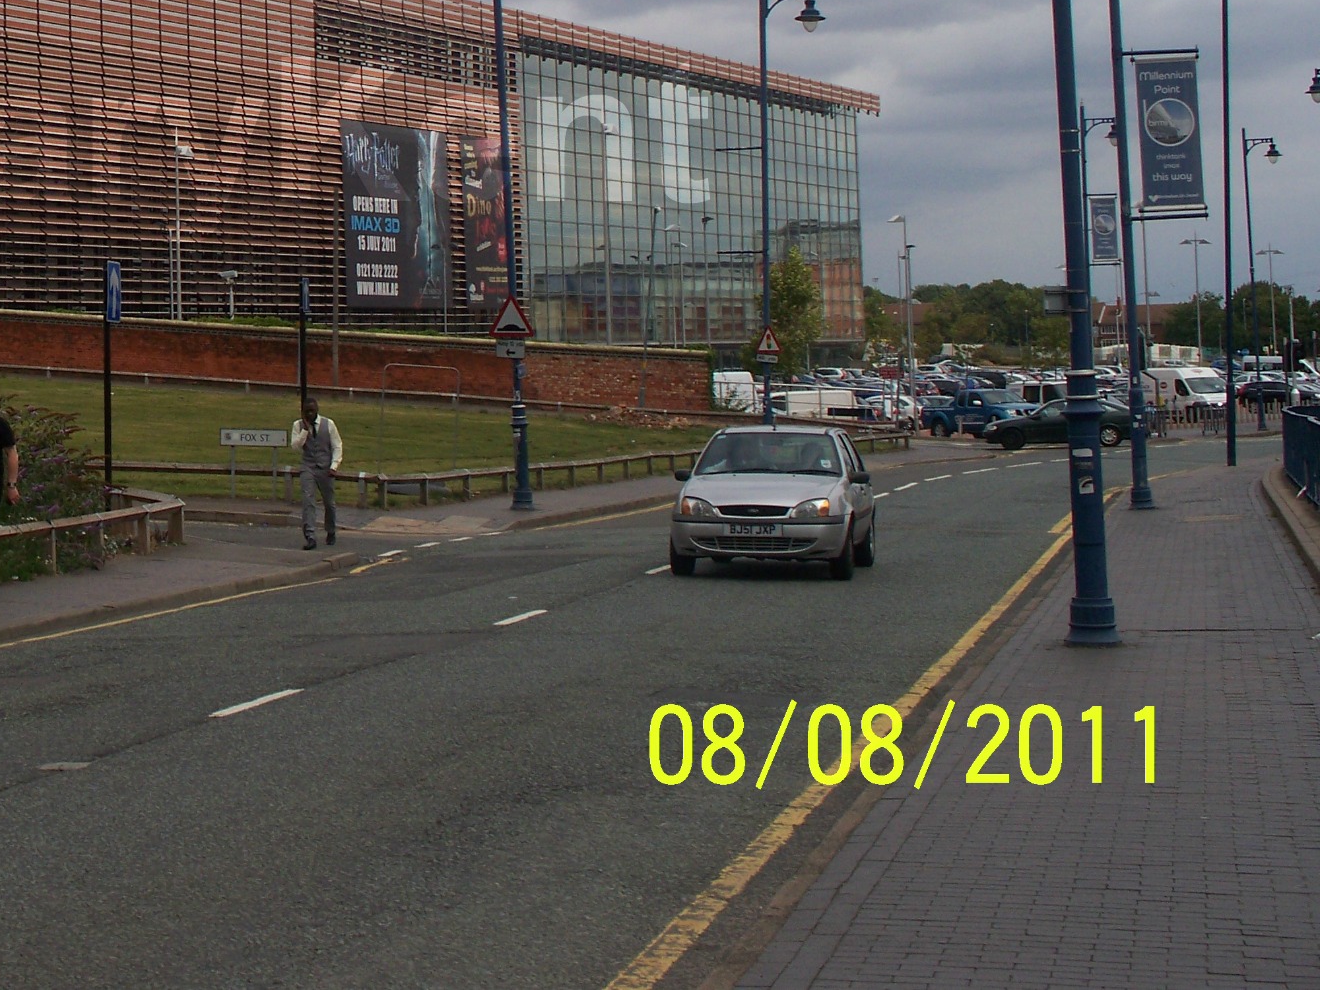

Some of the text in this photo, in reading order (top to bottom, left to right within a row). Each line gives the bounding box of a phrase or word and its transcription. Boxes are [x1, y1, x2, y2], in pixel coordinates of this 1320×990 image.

[1140, 71, 1194, 81] Millennium
[1154, 85, 1181, 94] Point
[1152, 172, 1192, 182] this way
[352, 195, 398, 214] OPENS HERE IN
[351, 215, 400, 233] IMAX 3D
[357, 235, 396, 252] 15 JULY 2011
[356, 263, 398, 278] 0121 202 2222
[240, 433, 270, 442] FOX ST
[730, 524, 776, 535] BJ51 JXP
